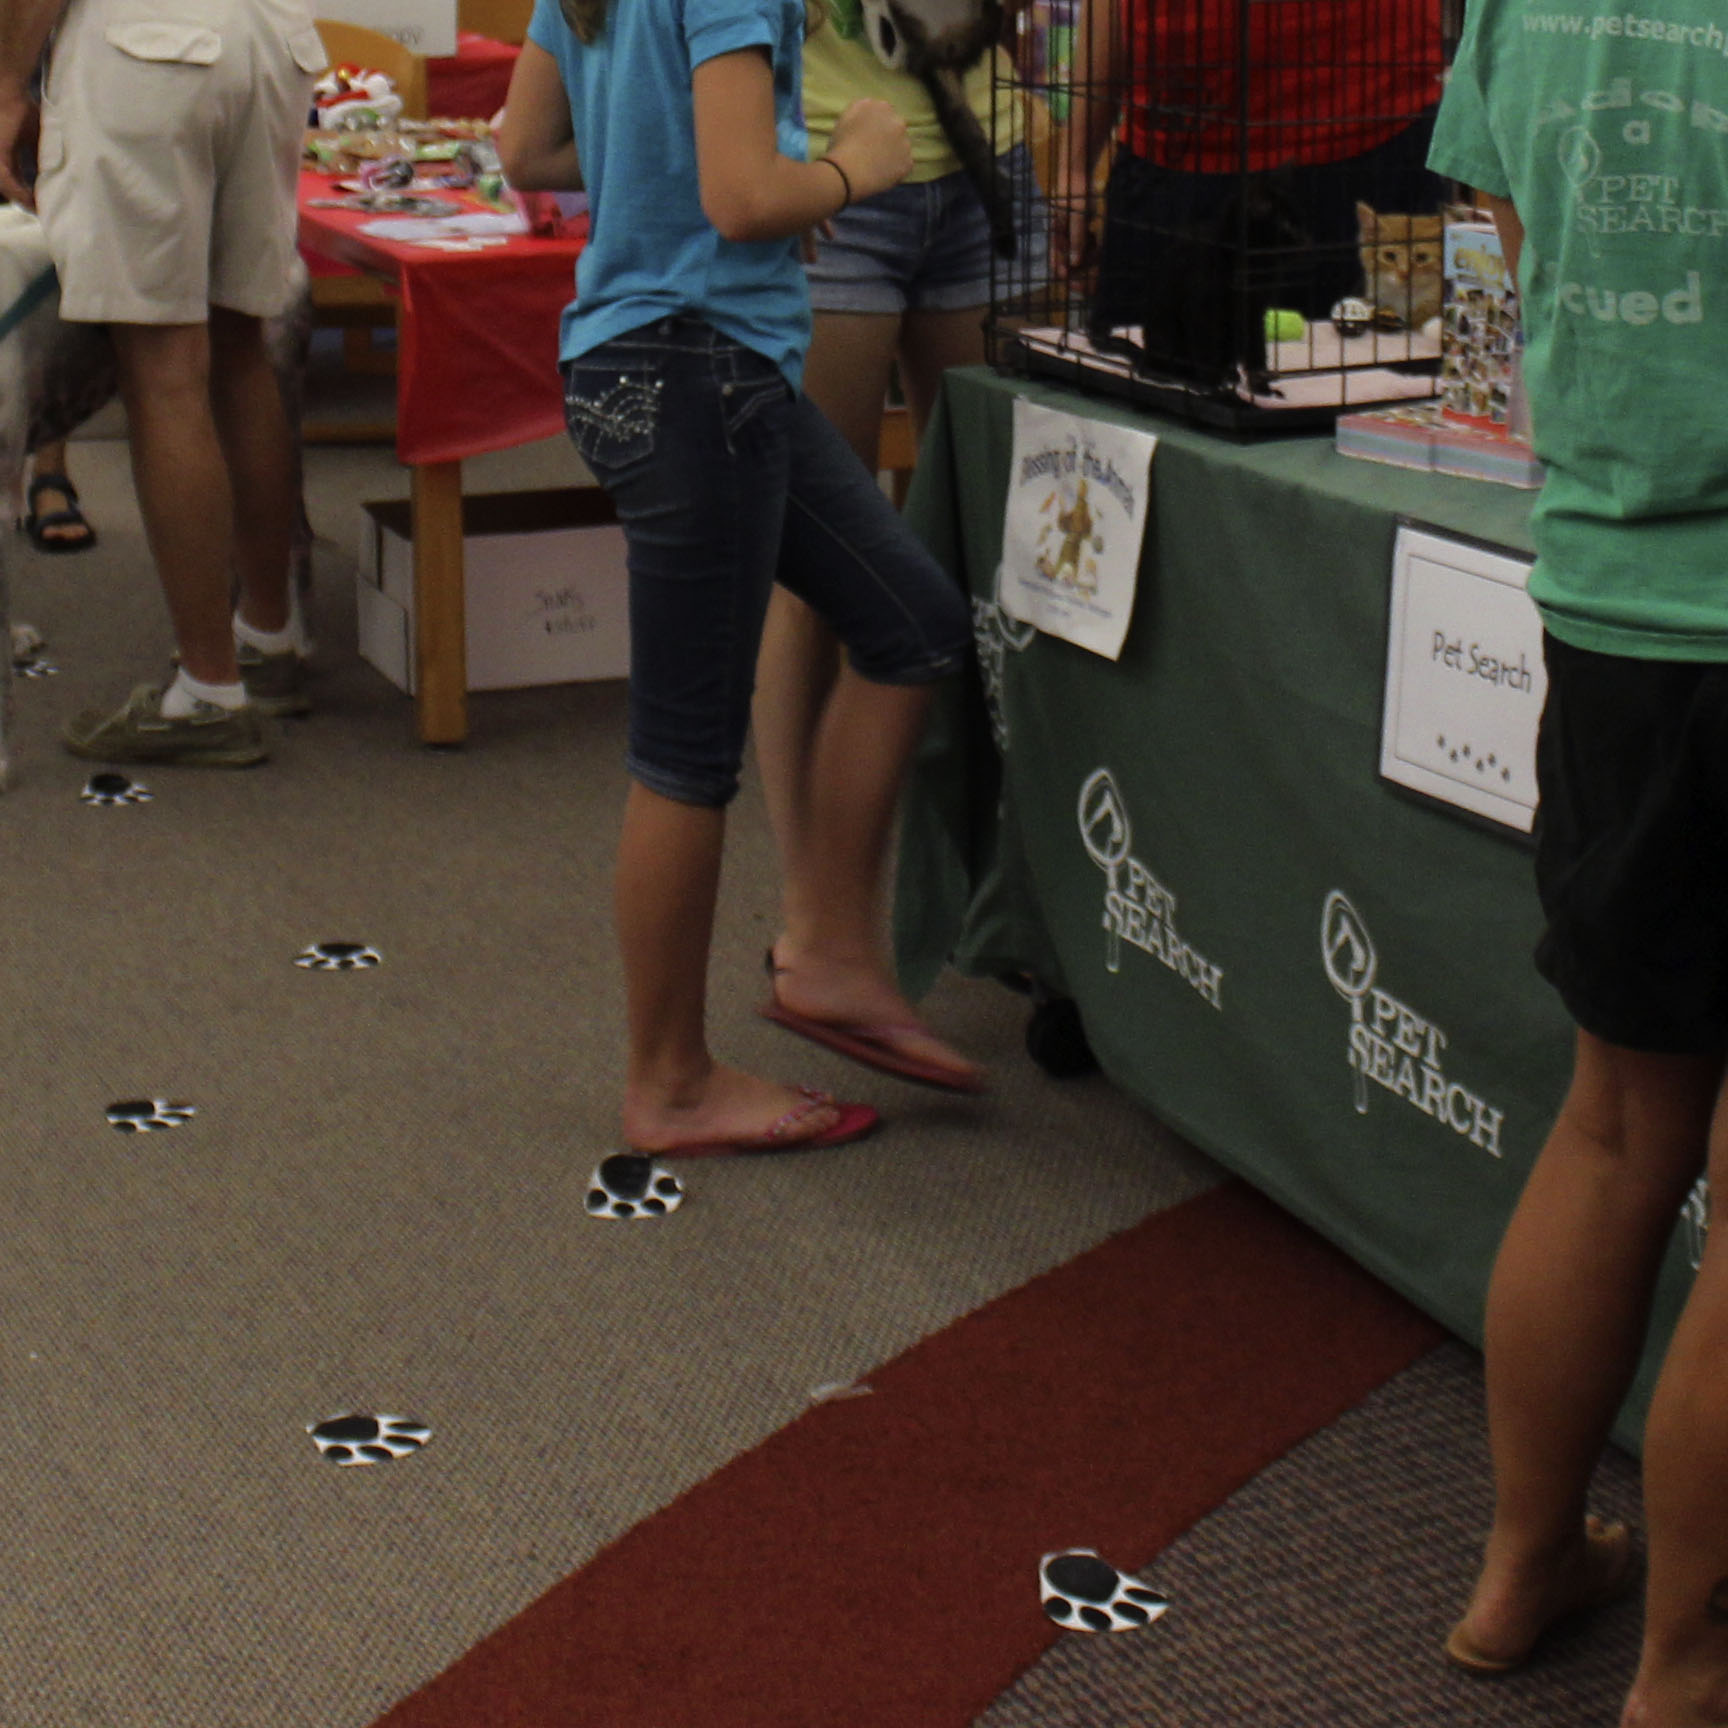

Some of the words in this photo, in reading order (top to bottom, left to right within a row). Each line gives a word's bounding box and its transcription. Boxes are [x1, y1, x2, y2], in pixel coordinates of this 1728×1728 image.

[1622, 120, 1651, 145] a
[1598, 174, 1681, 205] PET
[1433, 630, 1464, 671] Pet
[1466, 643, 1533, 694] Search
[1125, 854, 1177, 927] PET
[1101, 888, 1224, 1012] SEARCH
[1370, 987, 1448, 1070] PET
[1347, 1022, 1504, 1159] SEARCH
